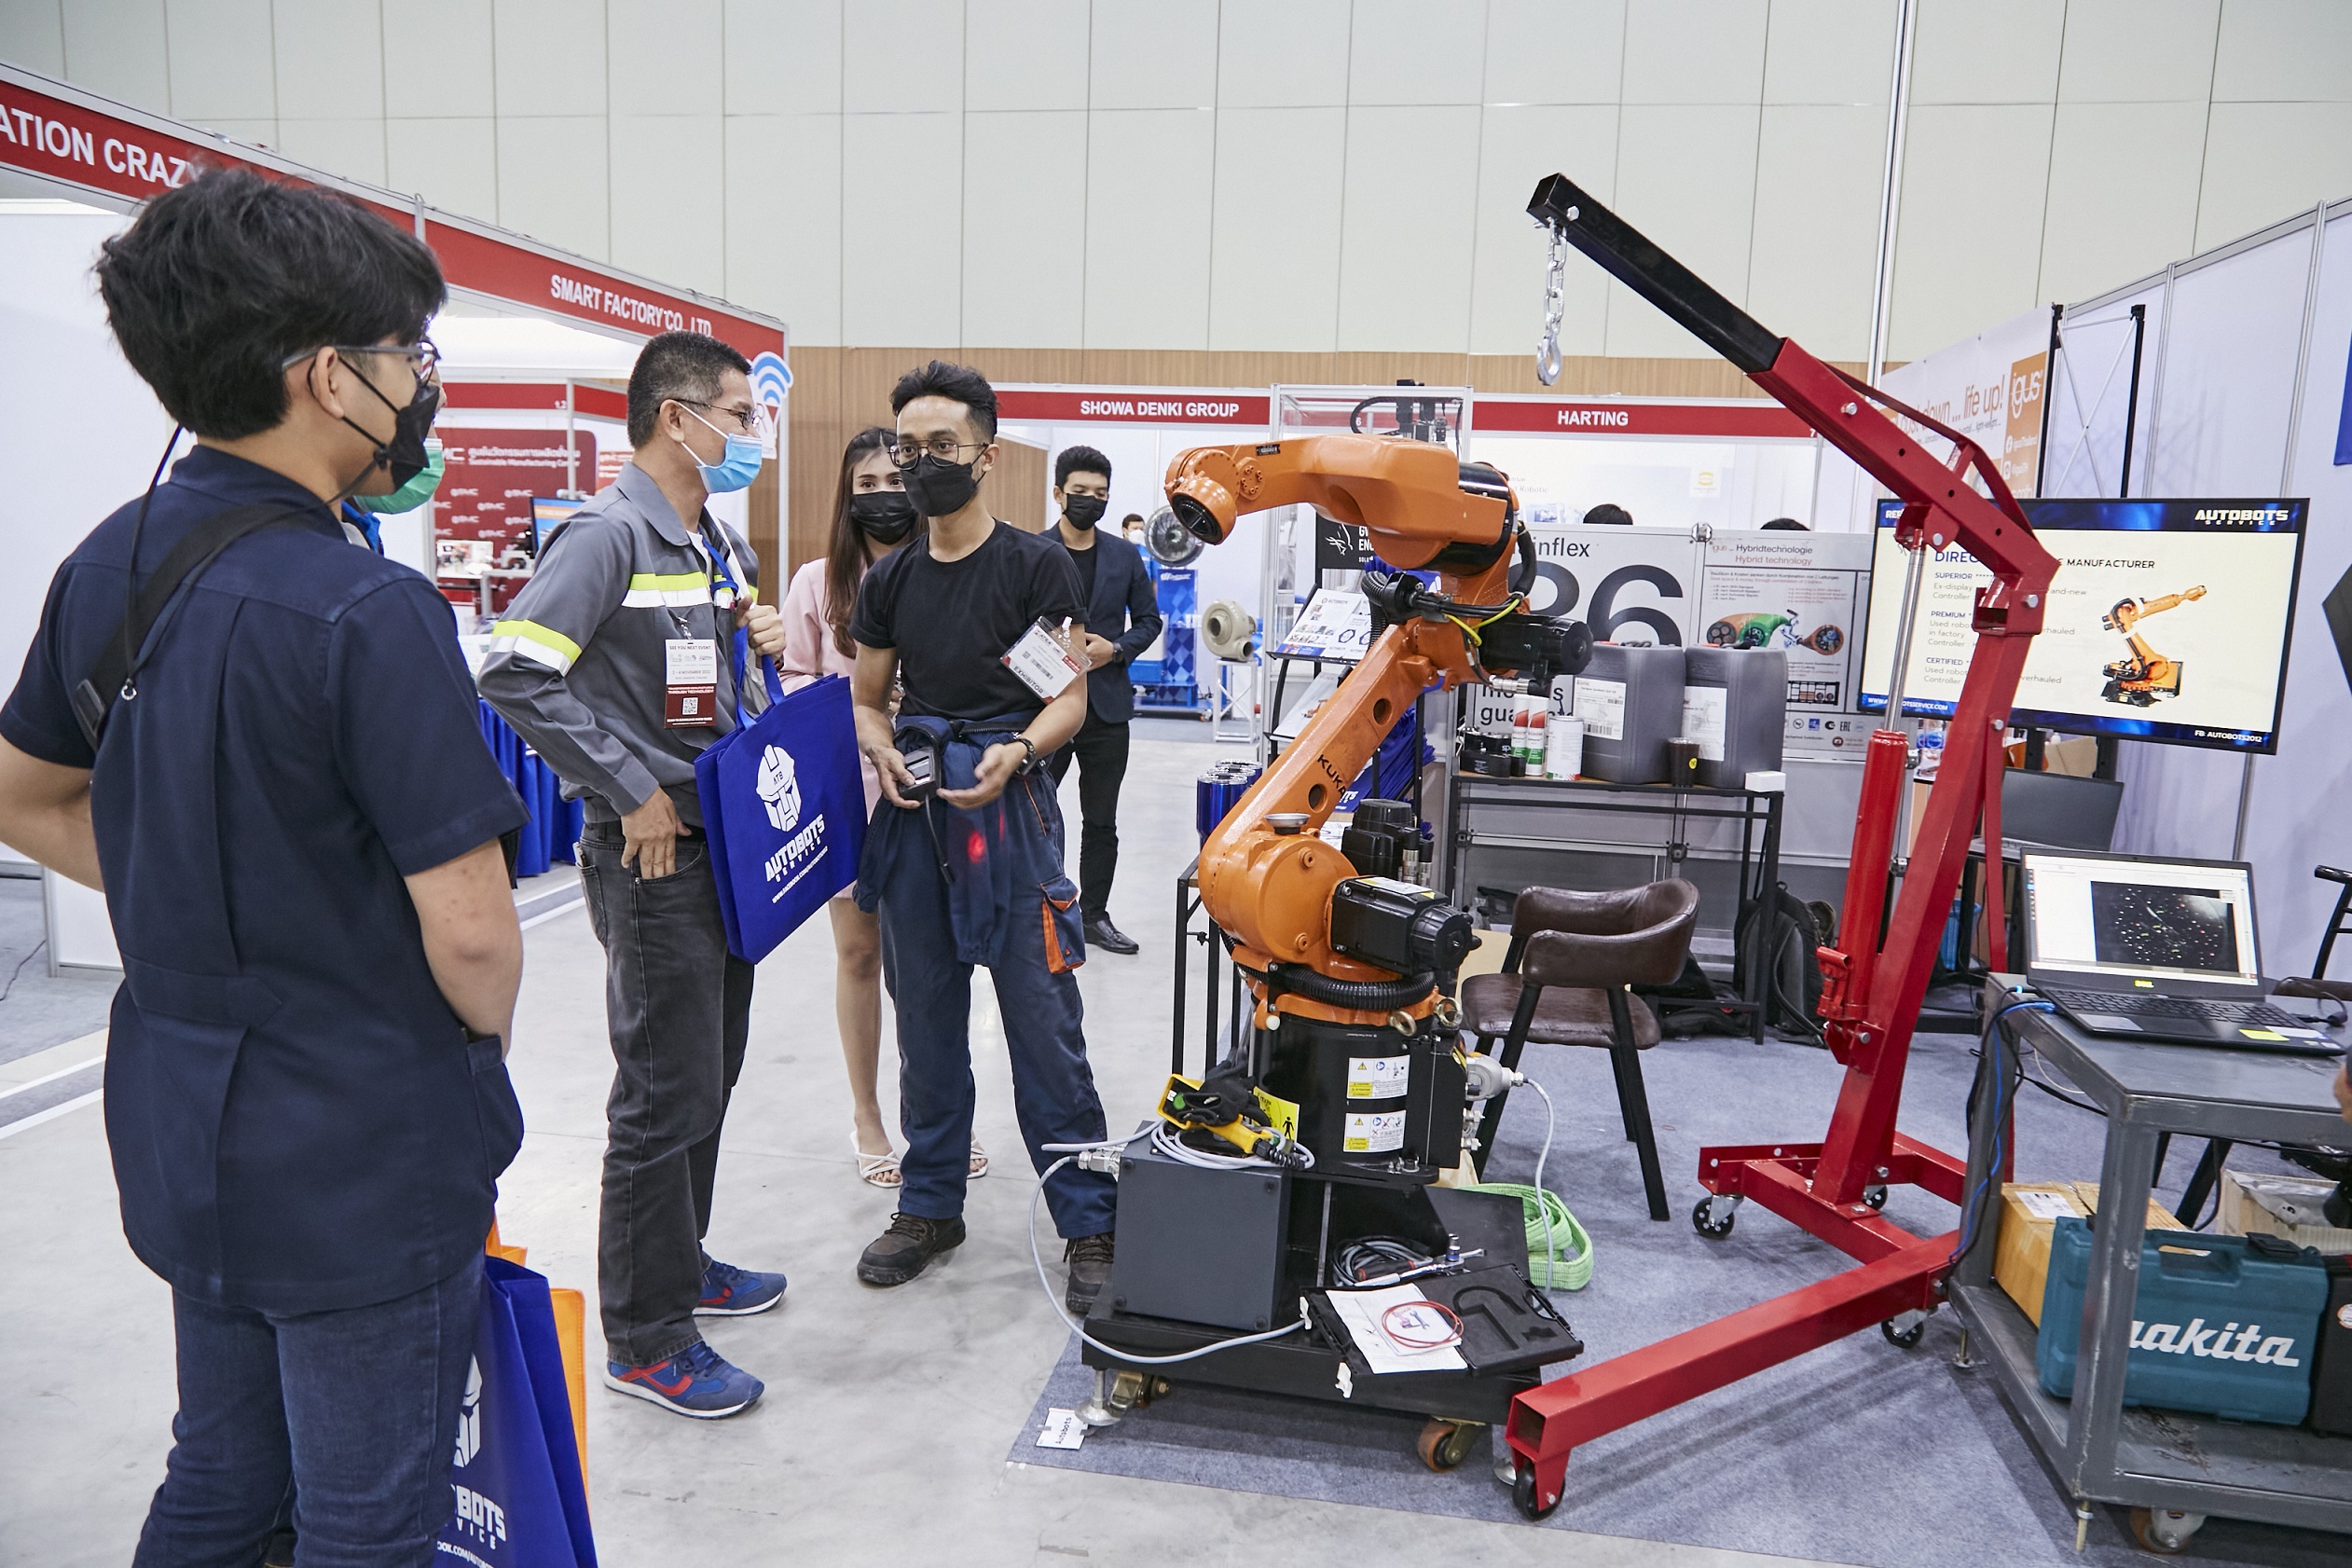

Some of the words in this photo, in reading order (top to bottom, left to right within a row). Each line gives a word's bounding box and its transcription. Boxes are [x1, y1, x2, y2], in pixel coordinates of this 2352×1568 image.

[551, 274, 602, 309] SMART
[604, 291, 662, 327] FACTORY
[1983, 374, 2005, 420] up!
[2011, 369, 2043, 419] igus
[1080, 400, 1135, 416] SHOWA
[1137, 401, 1182, 417] DENKI
[1186, 402, 1239, 417] GROUP
[1557, 409, 1629, 426] HARTING
[2194, 509, 2290, 521] AUTOBOTS
[1534, 537, 1590, 557] inflex
[1736, 543, 1813, 556] Hybridtechnologie
[1735, 555, 1763, 564] Hybrid
[1766, 557, 1812, 567] technology
[2067, 557, 2155, 569] MANUFACTURER
[1935, 571, 1973, 580] SUPERIOR
[1933, 583, 1973, 592] Ex-display
[2050, 587, 2087, 596] and-new
[1938, 630, 1965, 639] factory
[2043, 626, 2075, 635] rhauled
[1926, 657, 1963, 666] CERTIFIED
[1013, 666, 1044, 695] EXHIBITOR
[1924, 676, 1960, 684] Controller
[2021, 675, 2062, 684] verhauled
[2207, 731, 2263, 742] AUTOBOTS2012
[773, 771, 784, 786] ATB
[1317, 753, 1347, 799] KUKA
[764, 813, 825, 882] AUTOBOTS
[776, 836, 821, 883] SERVICE
[451, 1484, 506, 1542] BOTS
[457, 1517, 496, 1550] VICE
